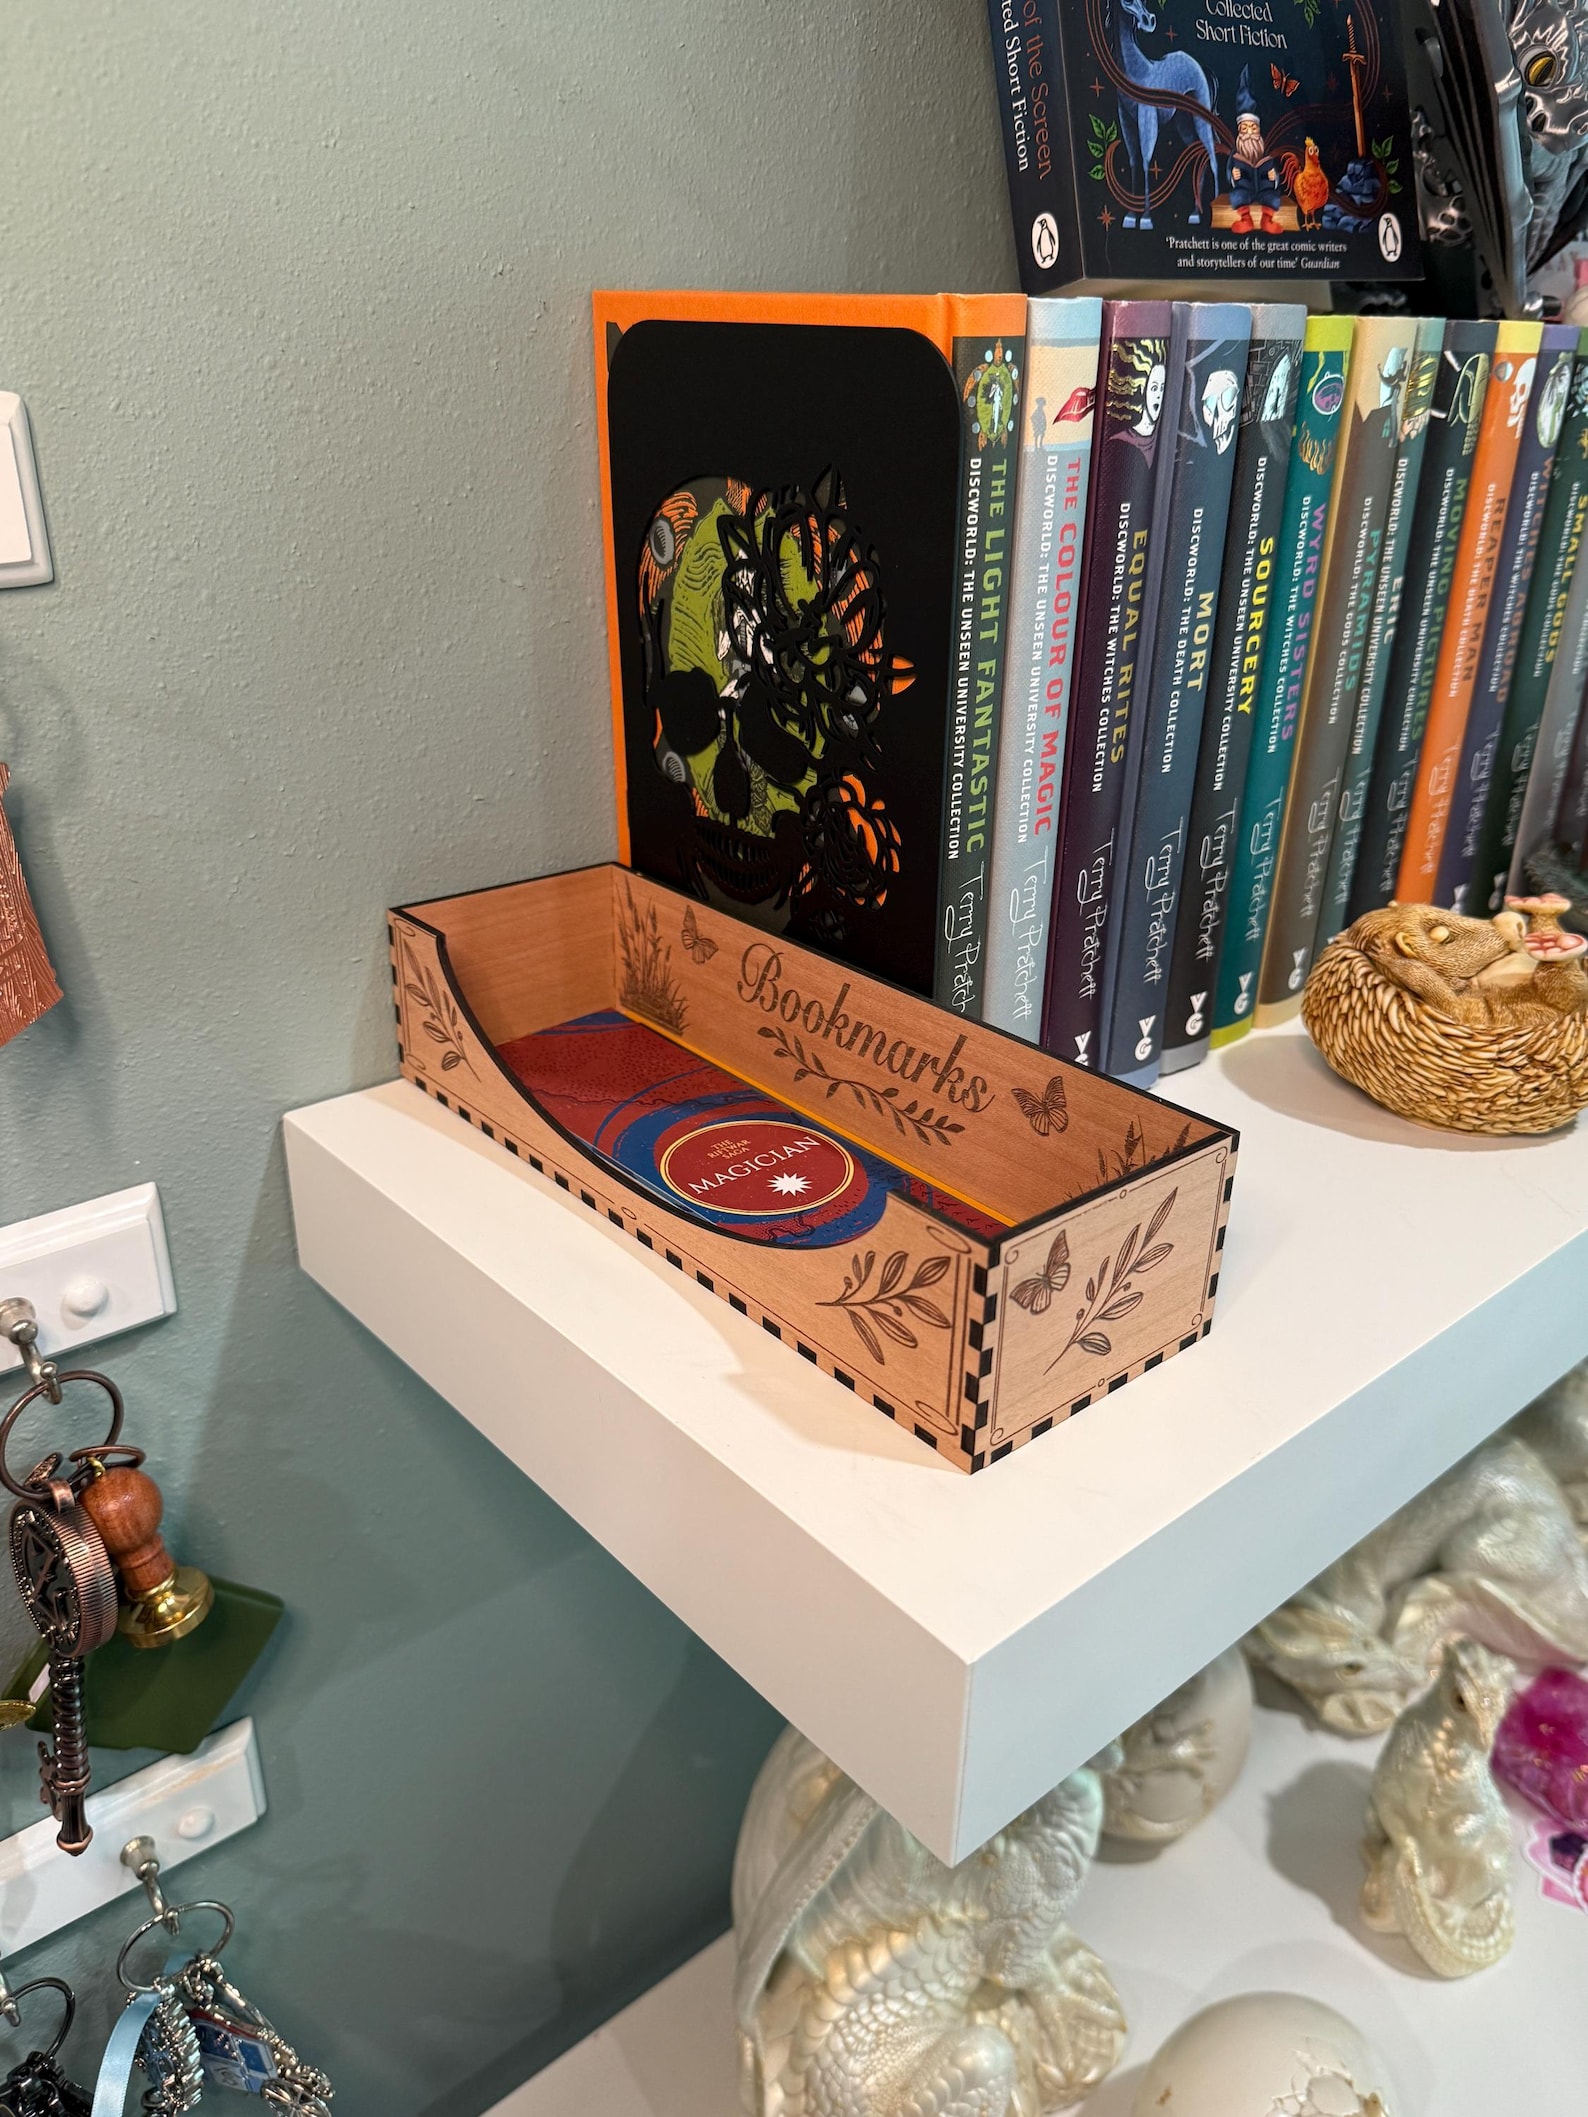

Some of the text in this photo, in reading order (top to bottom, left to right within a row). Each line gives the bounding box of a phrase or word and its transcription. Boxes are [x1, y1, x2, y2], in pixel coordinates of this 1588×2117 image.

[1005, 36, 1022, 96] Short
[1022, 0, 1052, 180] of the Screen
[1195, 19, 1288, 49] Short Fiction
[1205, 0, 1274, 22] Collected
[1012, 96, 1031, 172] Fiction
[1177, 254, 1194, 268] and
[1196, 255, 1246, 271] storytellers
[1247, 255, 1258, 269] of
[1259, 259, 1275, 269] our
[1300, 257, 1340, 270] Guardian
[1211, 238, 1219, 250] is
[1221, 241, 1238, 251] one
[1239, 237, 1250, 251] of
[1251, 238, 1265, 251] the
[1267, 241, 1289, 254] great
[1290, 240, 1316, 252] comic
[1317, 241, 1347, 253] writers
[1213, 456, 1268, 792] DISCWORLD: THE UNSEEN UNIVERSITY COLLECTION
[1267, 495, 1312, 754] DISCWORLD: THE WITCHES COLLECTION
[1281, 502, 1327, 741] WYRD SISTERS
[1328, 496, 1373, 725] DISCWORLD: THE GODS COLLECTION
[1345, 529, 1382, 691] PYRAMIDS
[1352, 457, 1409, 755] DISCWORLD: THE UNSEEN UNIVERSITY COLLECTION
[1384, 576, 1404, 645] ERIC
[1411, 478, 1468, 741] MOVING PICTURES
[1429, 545, 1441, 568] THE
[1461, 497, 1507, 682] REAPER MAN
[1561, 495, 1588, 584] SMALL
[947, 458, 982, 860] DISCWORLD: THE UNSEEN UNIVERSITY COLLECTION
[966, 458, 1007, 853] THE LIGHT FANTASTIC
[1017, 455, 1058, 844] DISCWORLD: THE UNSEEN UNIVERSITY COLLECTION
[1034, 457, 1081, 836] THE COLOUR OF MAGIC
[1091, 502, 1131, 793] DISCWORLD: THE WITCHES COLLECTION
[1110, 529, 1148, 764] EQUAL RITES
[1161, 508, 1204, 774] DISCWORLD: THE DEATH COLLECTION
[1187, 591, 1215, 692] MORT
[1237, 536, 1275, 715] SOURCERY
[1545, 592, 1568, 663] GODS
[944, 861, 985, 1013] Terry Pratch
[1009, 845, 1049, 1022] Terry Pratchett
[1076, 827, 1115, 1000] Terry Pratchett
[1143, 816, 1184, 986] Terry Pratchett
[1196, 797, 1238, 963] Terry Pratchett
[737, 943, 996, 1113] Bookmarks
[688, 1136, 821, 1195] MAGICIAN
[707, 1139, 752, 1159] RIFTWAR
[710, 1139, 734, 1149] THE
